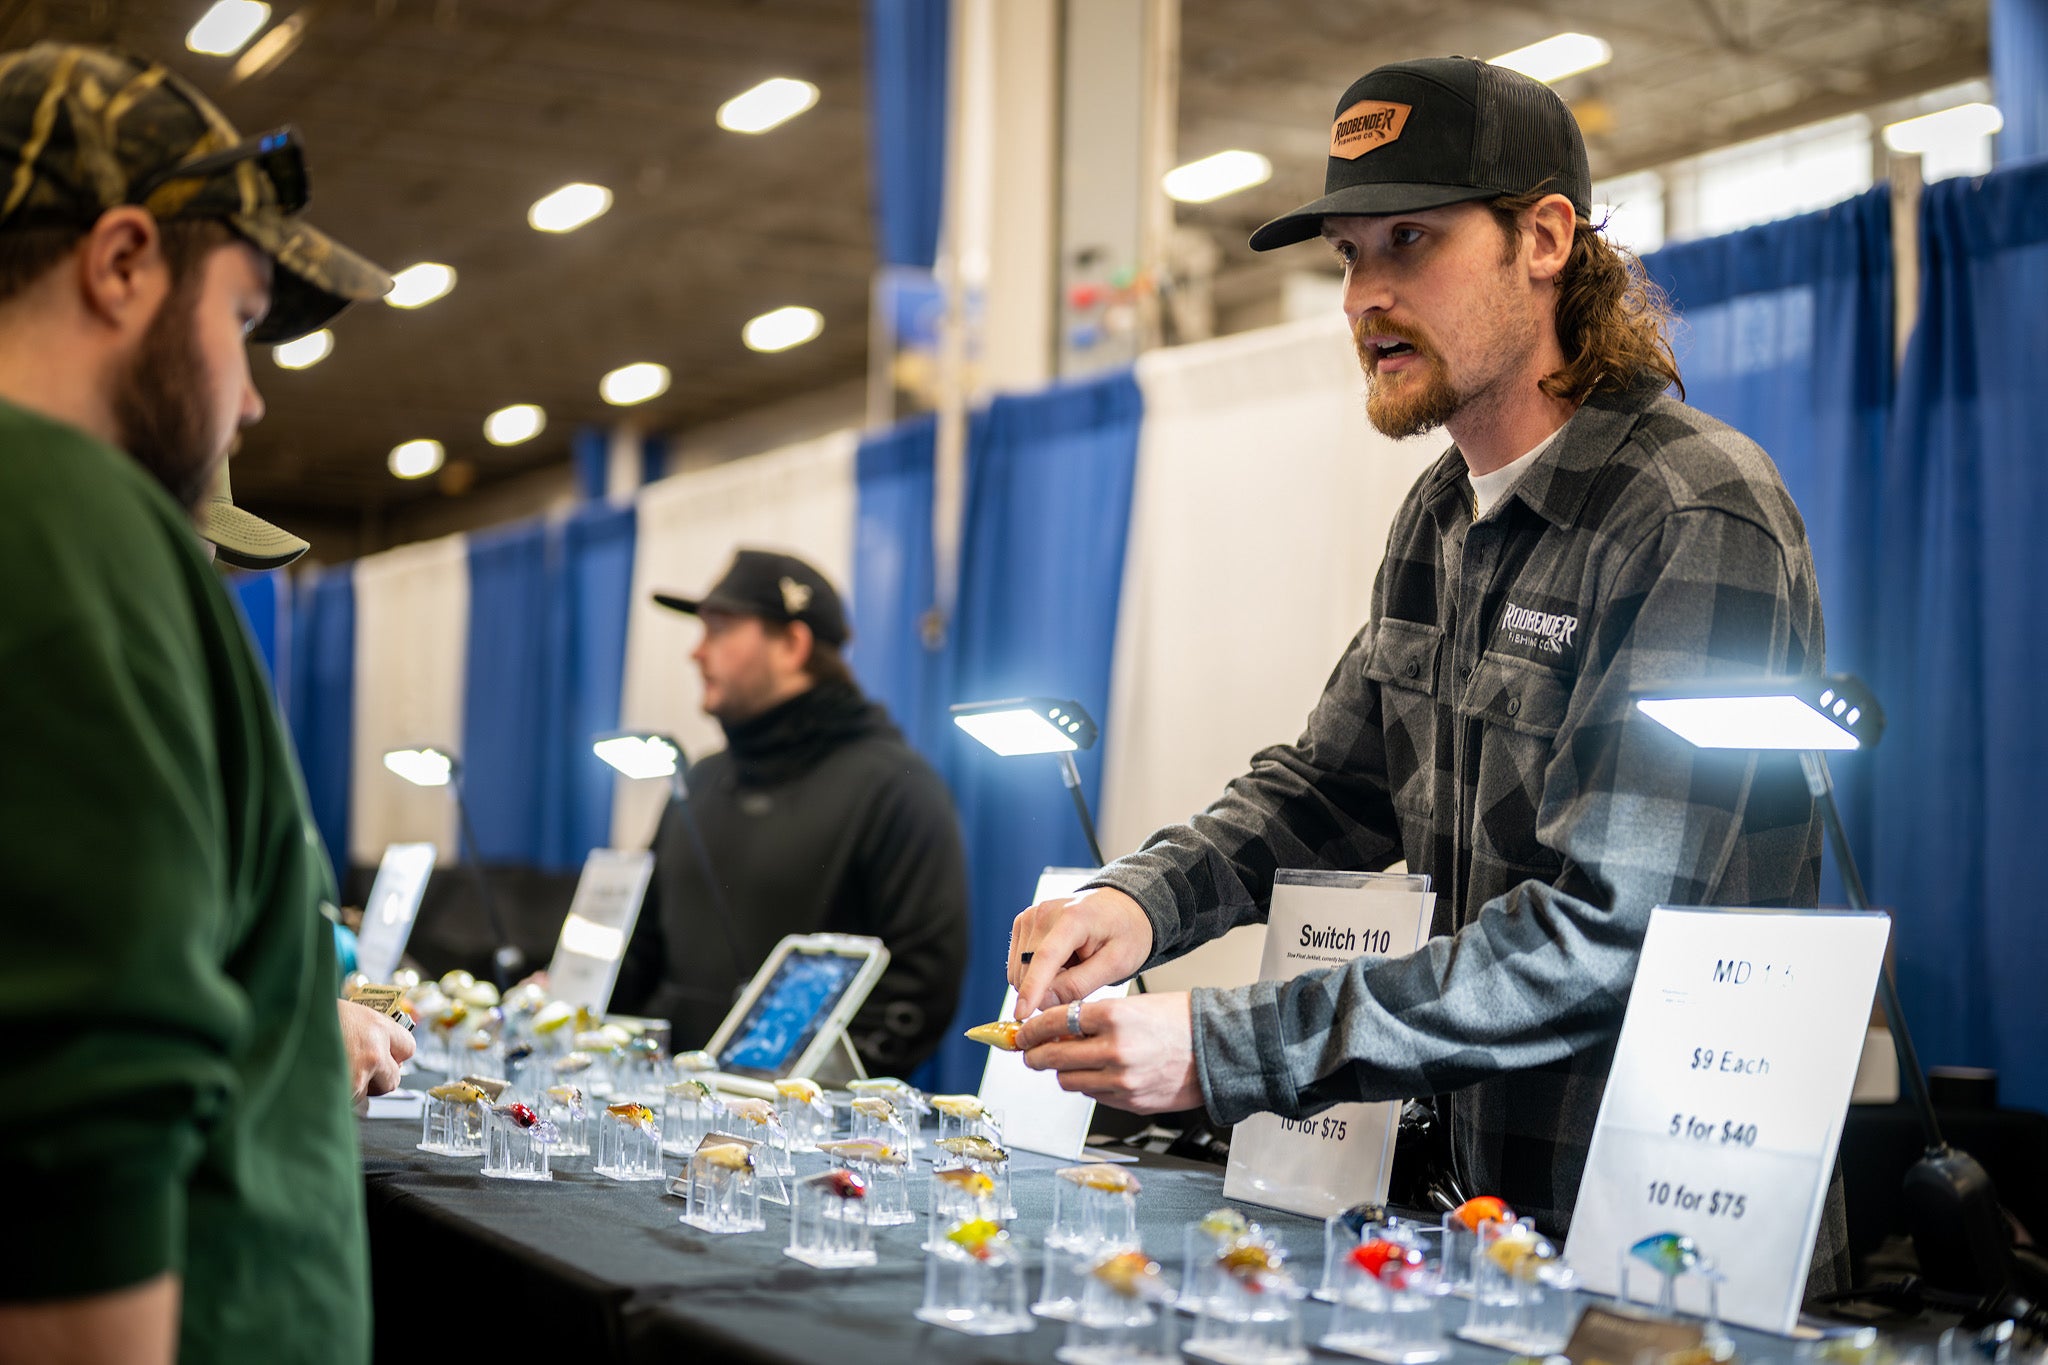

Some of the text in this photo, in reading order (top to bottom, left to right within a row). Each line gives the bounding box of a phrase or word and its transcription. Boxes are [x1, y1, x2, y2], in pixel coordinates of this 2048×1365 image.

[1333, 108, 1396, 144] RODBENDER
[1338, 135, 1362, 146] FISHING
[1501, 601, 1578, 648] RODBENDER
[1299, 924, 1390, 954] Switch 110
[1712, 959, 1752, 985] MD
[1691, 1047, 1770, 1075] $9 Each
[1281, 1116, 1347, 1141] 10 for $75
[1669, 1113, 1758, 1148] 5 for $40
[1648, 1180, 1747, 1220] 10 for $75
